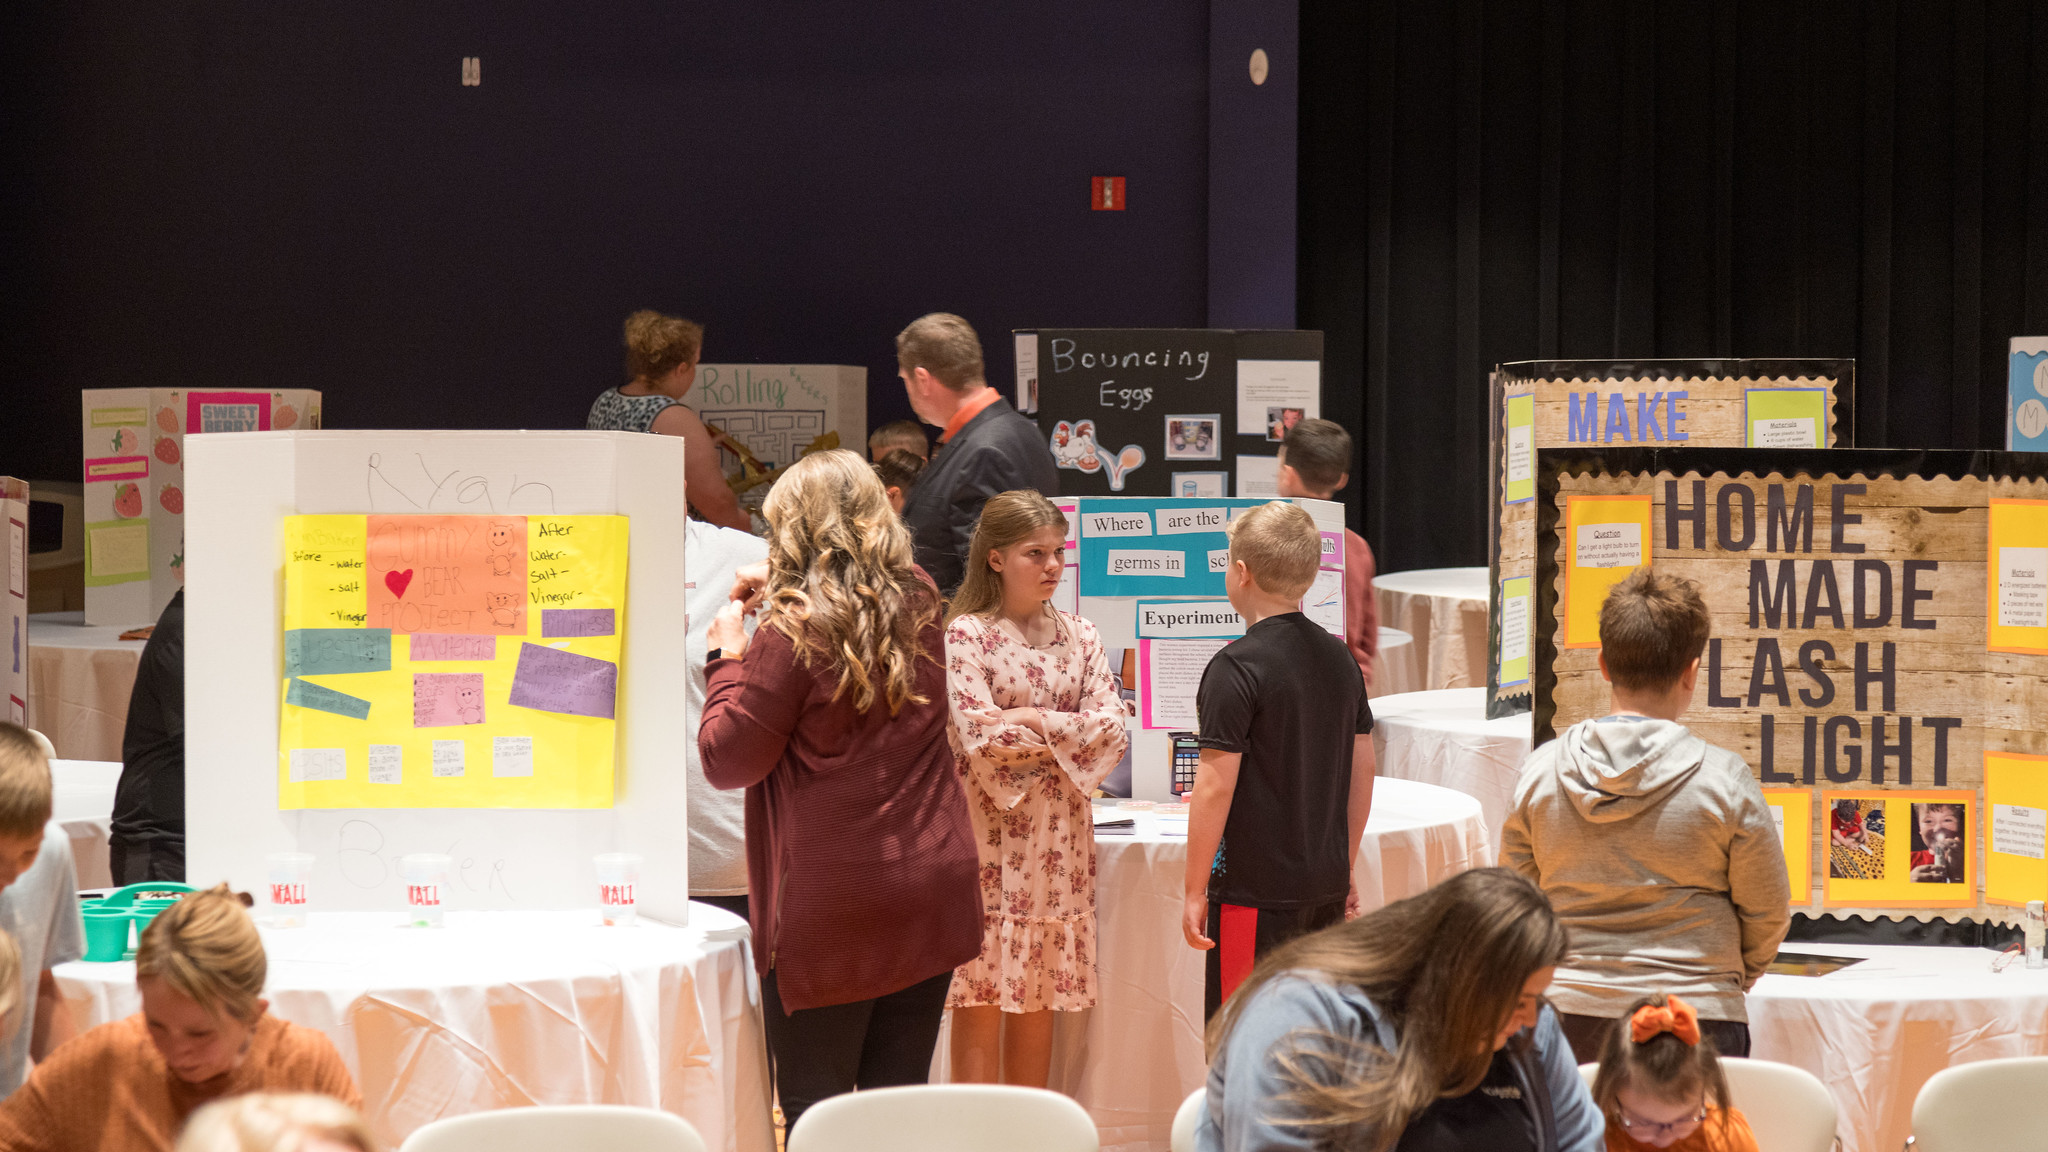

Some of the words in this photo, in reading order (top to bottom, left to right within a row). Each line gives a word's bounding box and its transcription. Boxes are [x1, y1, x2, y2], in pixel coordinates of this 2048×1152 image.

[1051, 338, 1210, 380] Bouncing
[698, 367, 788, 408] Rolling
[1100, 380, 1153, 410] Eggs
[203, 405, 257, 419] SWEET
[1568, 390, 1689, 443] MAKE
[539, 522, 574, 537] After
[1094, 517, 1144, 532] Where
[1168, 516, 1191, 528] are
[1196, 511, 1220, 526] the
[1594, 530, 1621, 539] Question
[1665, 480, 1868, 554] HOME
[1113, 556, 1161, 573] germs
[1166, 555, 1180, 570] in
[1749, 559, 1938, 630] MADE
[1144, 609, 1240, 627] Experiment
[1707, 638, 1897, 712] LASH
[1761, 714, 1962, 786] LIGHT
